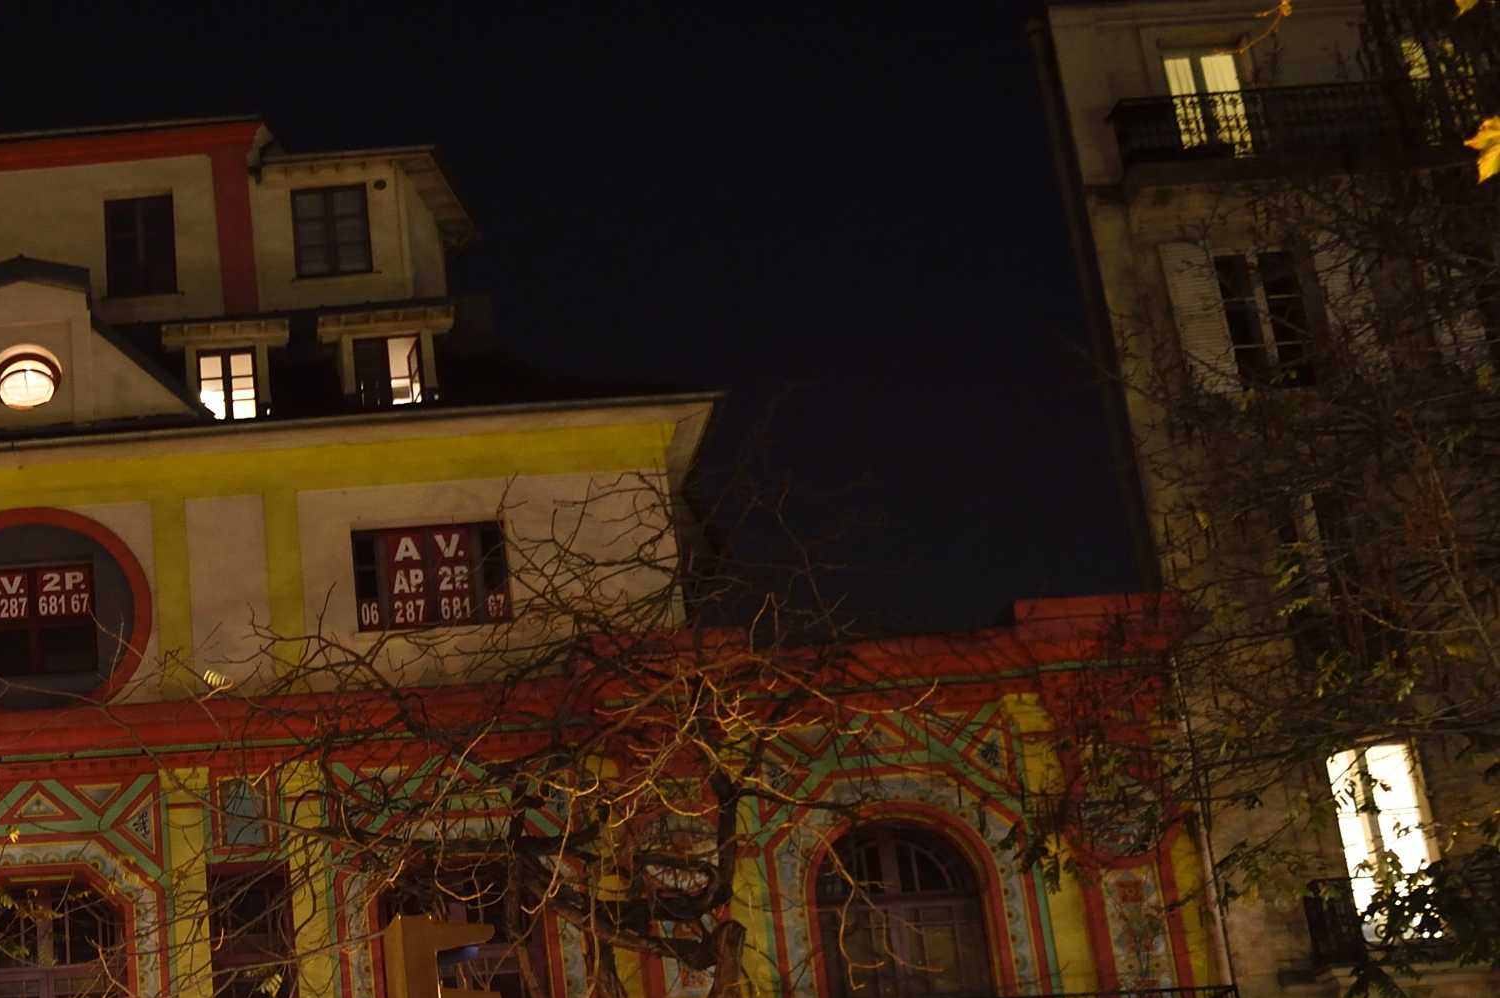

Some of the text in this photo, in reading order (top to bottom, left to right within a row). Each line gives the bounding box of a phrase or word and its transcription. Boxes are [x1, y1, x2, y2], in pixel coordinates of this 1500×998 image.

[0, 597, 28, 618] 287
[38, 594, 66, 616] 681
[70, 593, 89, 613] 67
[361, 602, 379, 625] 06
[394, 599, 425, 624] 287
[440, 596, 471, 620] 681
